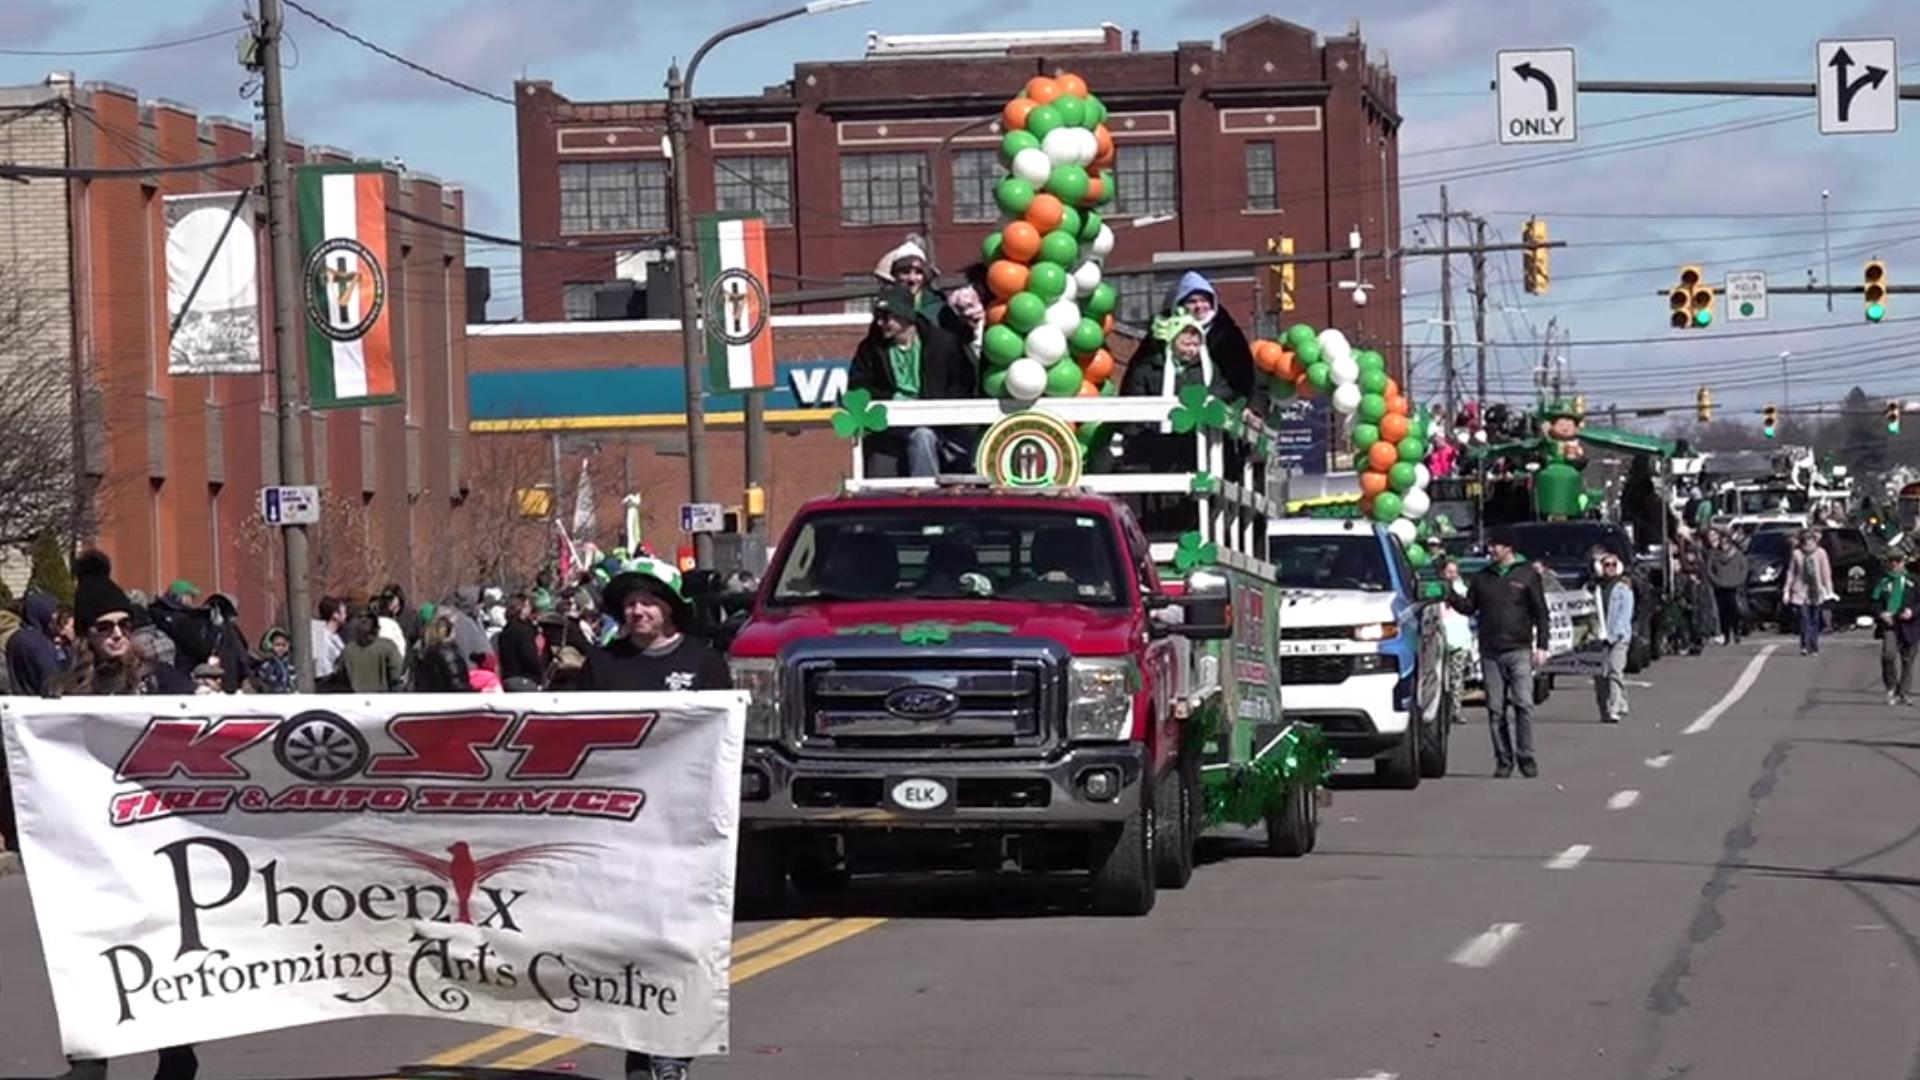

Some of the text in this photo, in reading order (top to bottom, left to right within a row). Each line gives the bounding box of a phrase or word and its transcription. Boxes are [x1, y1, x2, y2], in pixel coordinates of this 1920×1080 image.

[1509, 116, 1565, 137] ONLY
[901, 693, 942, 712] Ford
[114, 709, 659, 782] KOST
[111, 785, 645, 825] TIRE & AUTO SERVICE
[904, 786, 935, 802] ELK
[154, 836, 527, 962] Phoenix
[99, 933, 678, 1025] Performing Arts Centre
